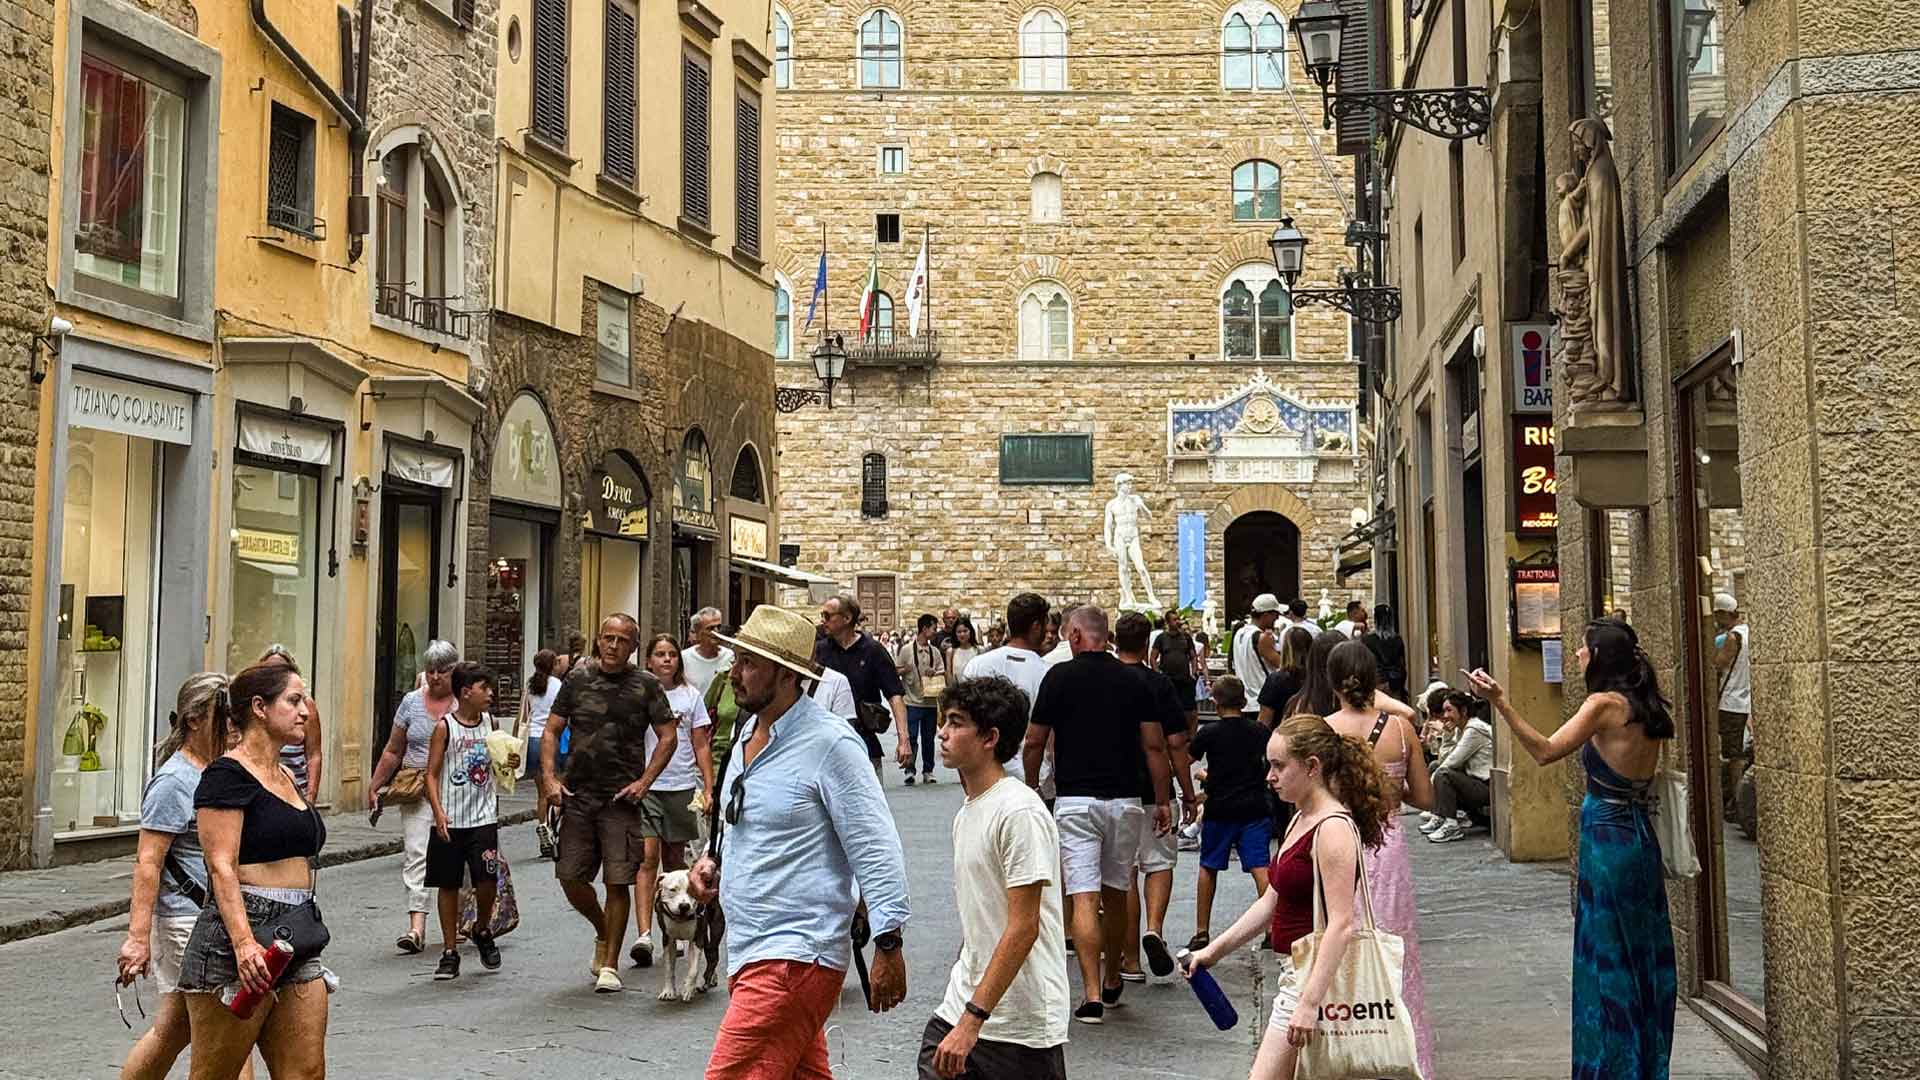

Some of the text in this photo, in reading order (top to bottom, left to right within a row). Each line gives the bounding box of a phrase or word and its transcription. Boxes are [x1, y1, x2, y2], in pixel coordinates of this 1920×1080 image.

[74, 385, 184, 431] TIZIANO COLASANTE
[1517, 569, 1556, 580] TRATTORIA
